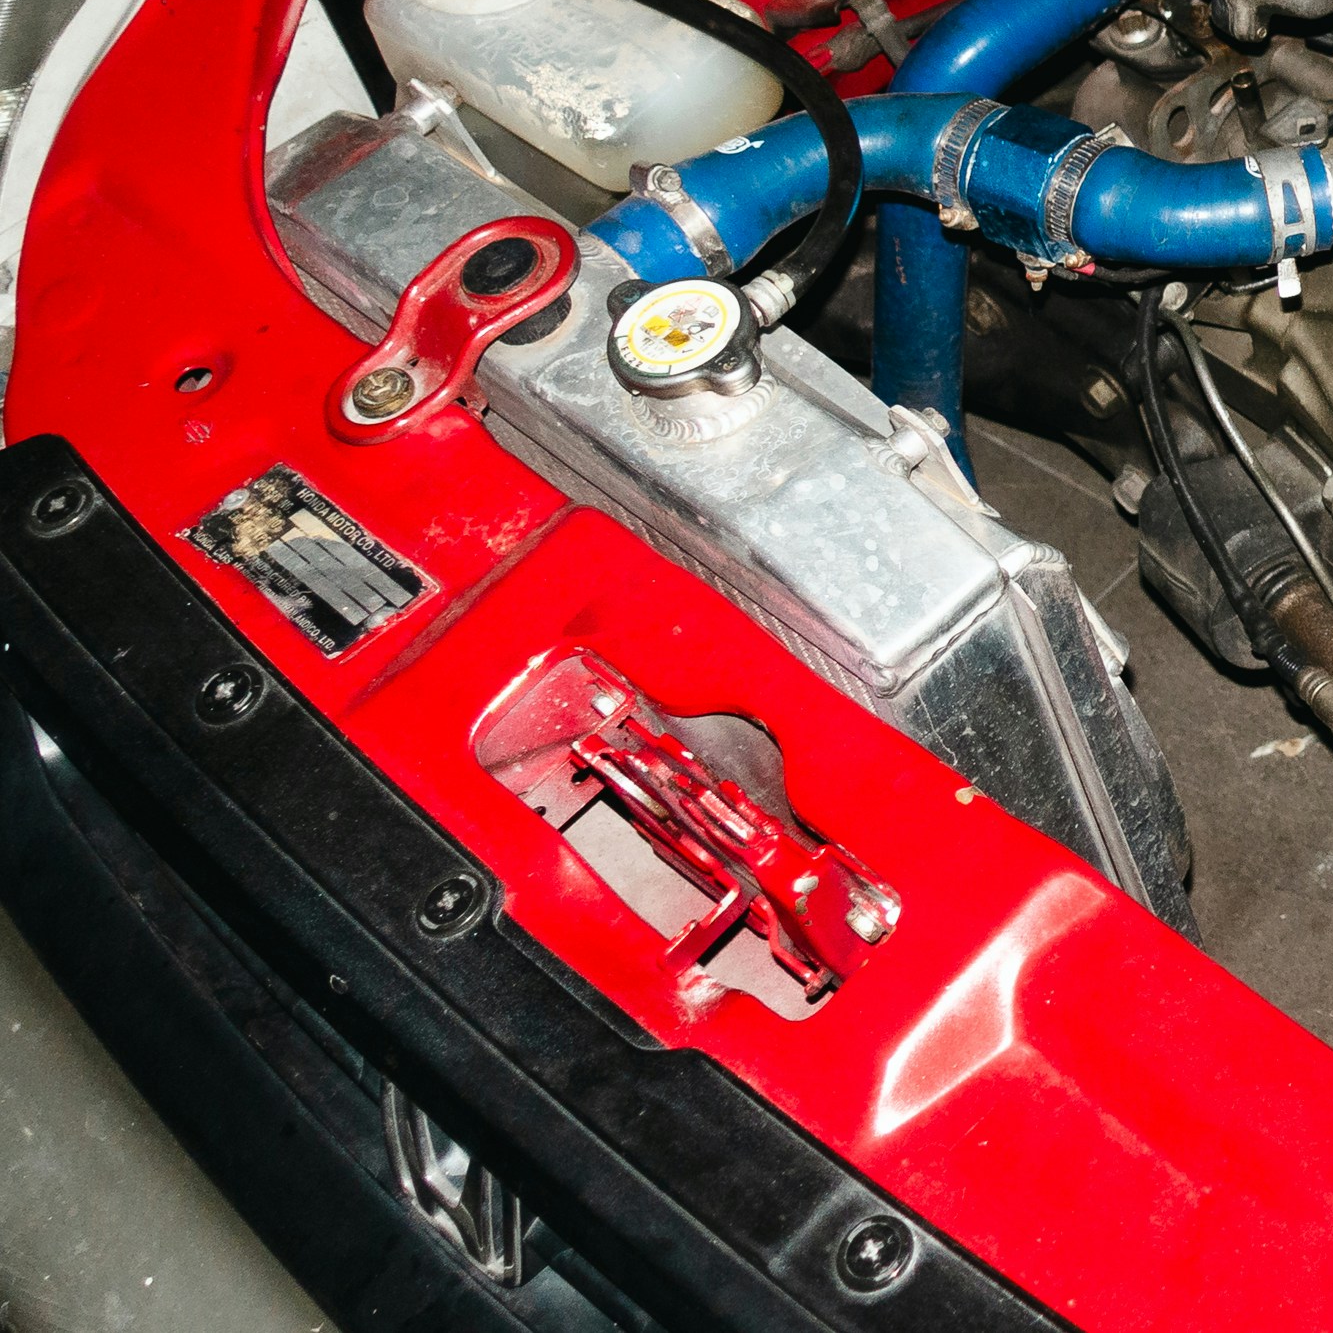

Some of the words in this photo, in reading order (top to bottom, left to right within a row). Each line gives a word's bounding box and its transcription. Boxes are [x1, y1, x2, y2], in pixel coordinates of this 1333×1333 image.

[296, 487, 329, 517] HONDA
[325, 511, 361, 541] MOTOR
[373, 550, 396, 571] LTD.
[192, 530, 218, 551] HONDA
[212, 547, 235, 564] CARS
[318, 634, 337, 652] LTD.
